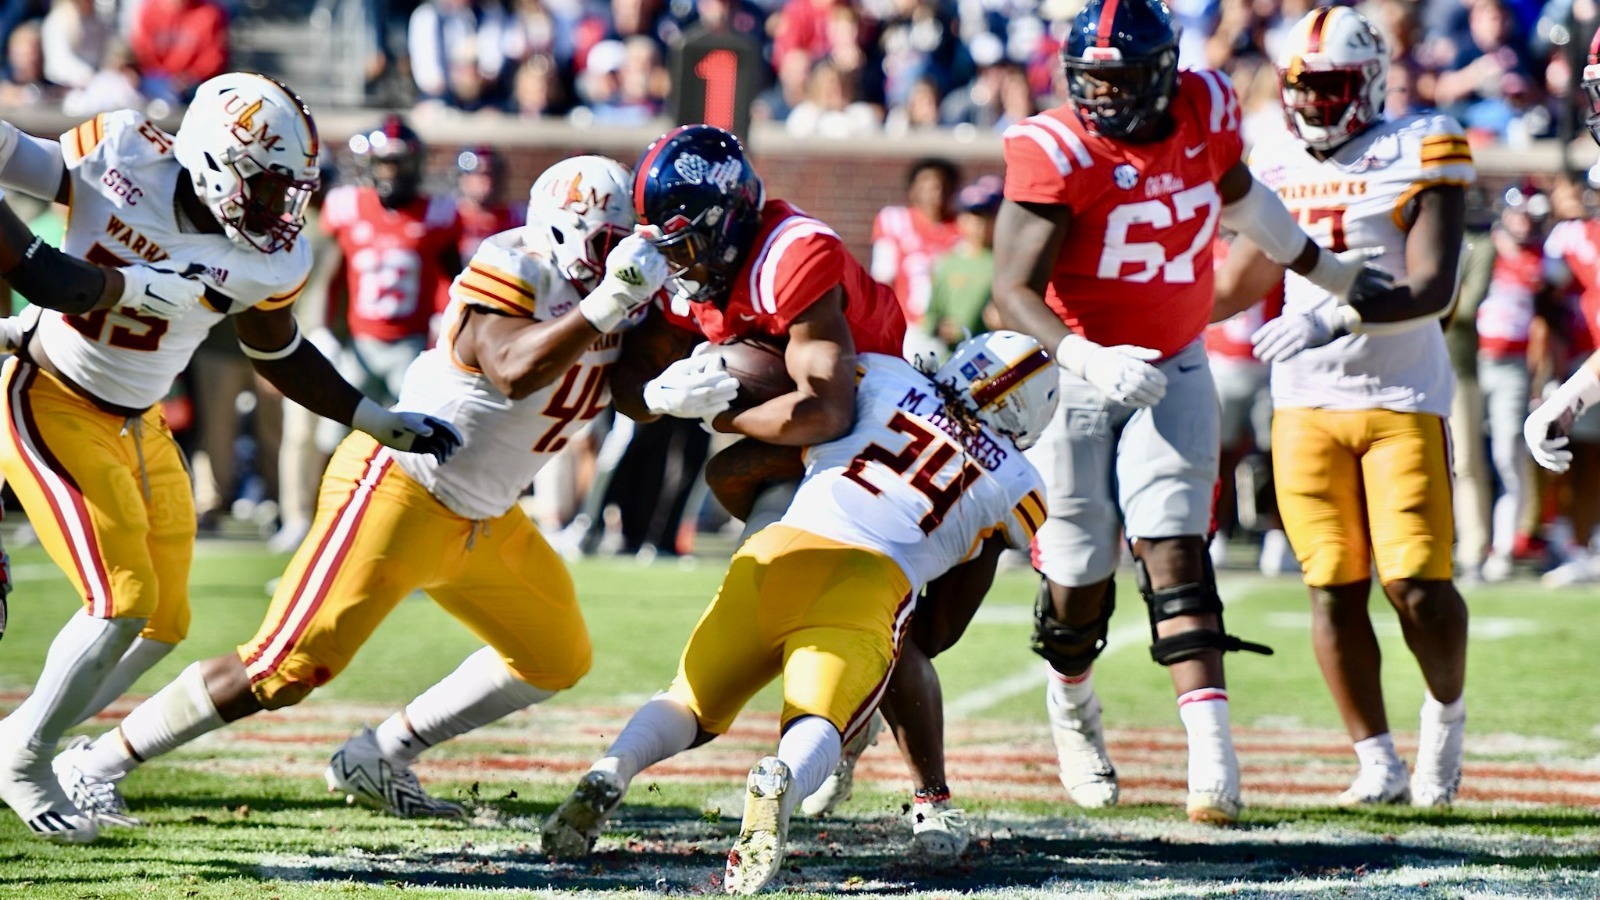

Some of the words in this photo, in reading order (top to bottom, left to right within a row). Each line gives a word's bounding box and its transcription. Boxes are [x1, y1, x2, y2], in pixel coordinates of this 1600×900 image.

[694, 50, 738, 132] 1
[224, 94, 283, 153] ULM
[103, 169, 143, 206] SBC
[1096, 180, 1223, 284] 67
[1288, 205, 1349, 254] 7
[897, 387, 927, 416] M.
[841, 411, 983, 537] 24
